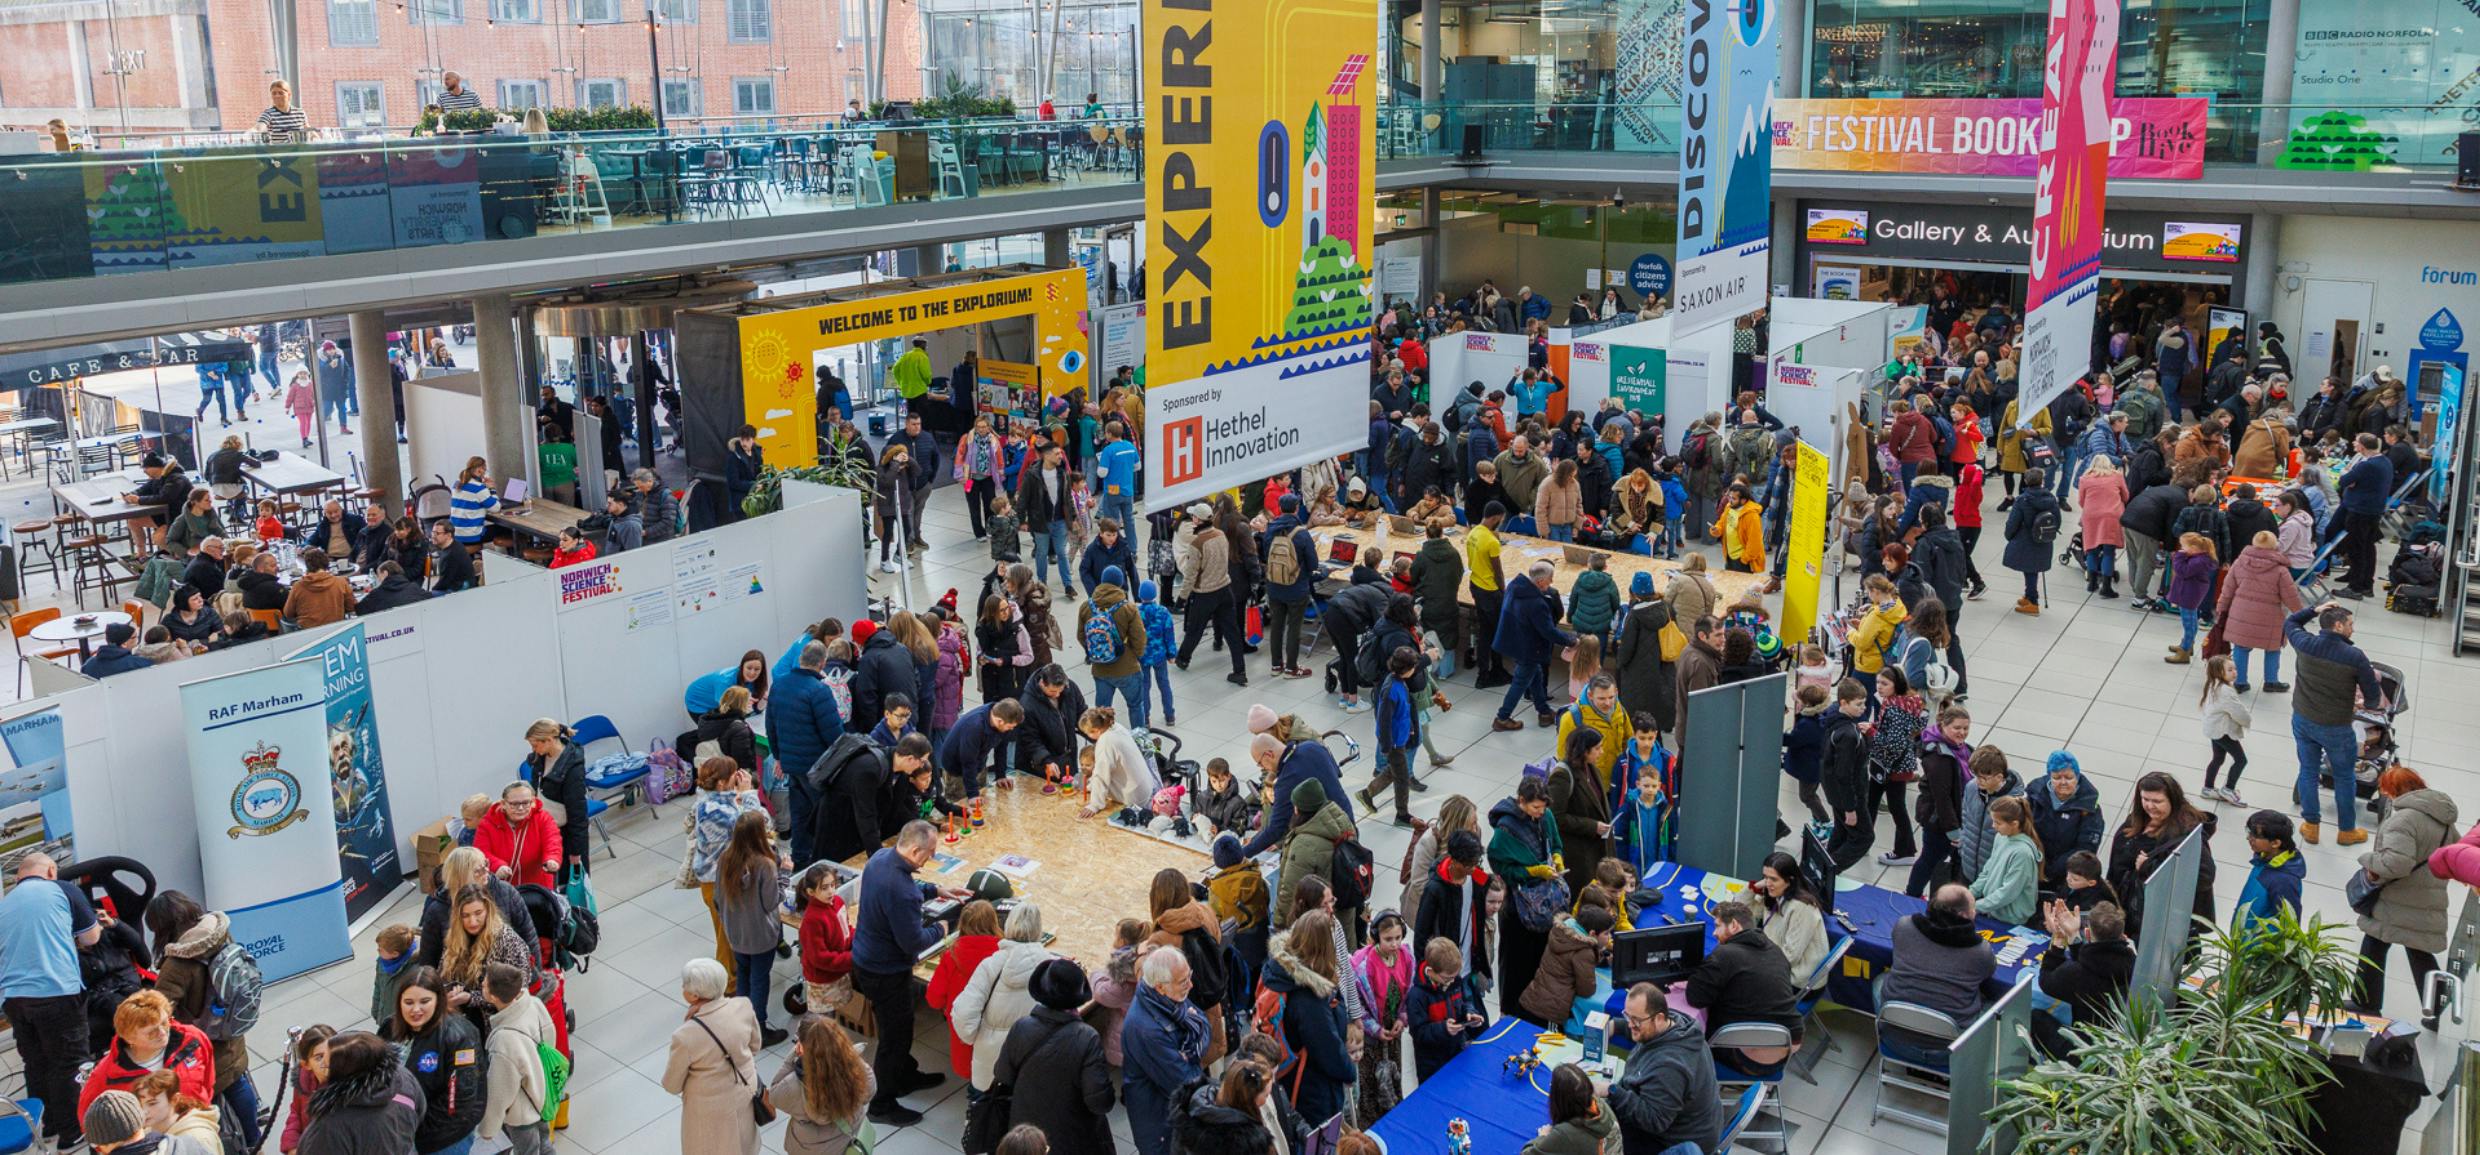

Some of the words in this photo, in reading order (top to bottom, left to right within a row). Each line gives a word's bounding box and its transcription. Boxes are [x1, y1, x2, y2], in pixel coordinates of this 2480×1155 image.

[2377, 30, 2432, 38] NORFOLK
[2301, 75, 2334, 85] Studio
[2337, 75, 2361, 84] One
[1806, 115, 1943, 153] FESTIVAL
[1953, 117, 2132, 157] BOOKP
[1875, 219, 1965, 247] Gallery
[1974, 225, 1992, 243] &
[1635, 271, 1666, 280] citizens
[1638, 262, 1663, 271] Norfolk
[1637, 280, 1664, 289] advice
[1680, 287, 1723, 313] SAXON
[1726, 277, 1745, 298] AIR
[819, 308, 893, 336] WELCOME
[899, 305, 917, 322] TO
[922, 300, 949, 319] THE
[954, 287, 1032, 313] EXPLORIUM!
[28, 359, 101, 384] CAFE
[118, 355, 132, 368] &
[1163, 390, 1209, 413] Sponsored
[1211, 388, 1222, 401] by
[1206, 406, 1266, 443] Hethel
[1206, 427, 1299, 469] Innovation
[561, 563, 611, 584] NORWICH
[561, 575, 606, 594] SCIENCE
[562, 585, 614, 605] FESTIVAL
[209, 704, 239, 721] RAF
[242, 693, 303, 713] Marham
[6, 714, 60, 737] MARHAM
[247, 934, 285, 952] ROYAL
[252, 942, 286, 959] ORCE
